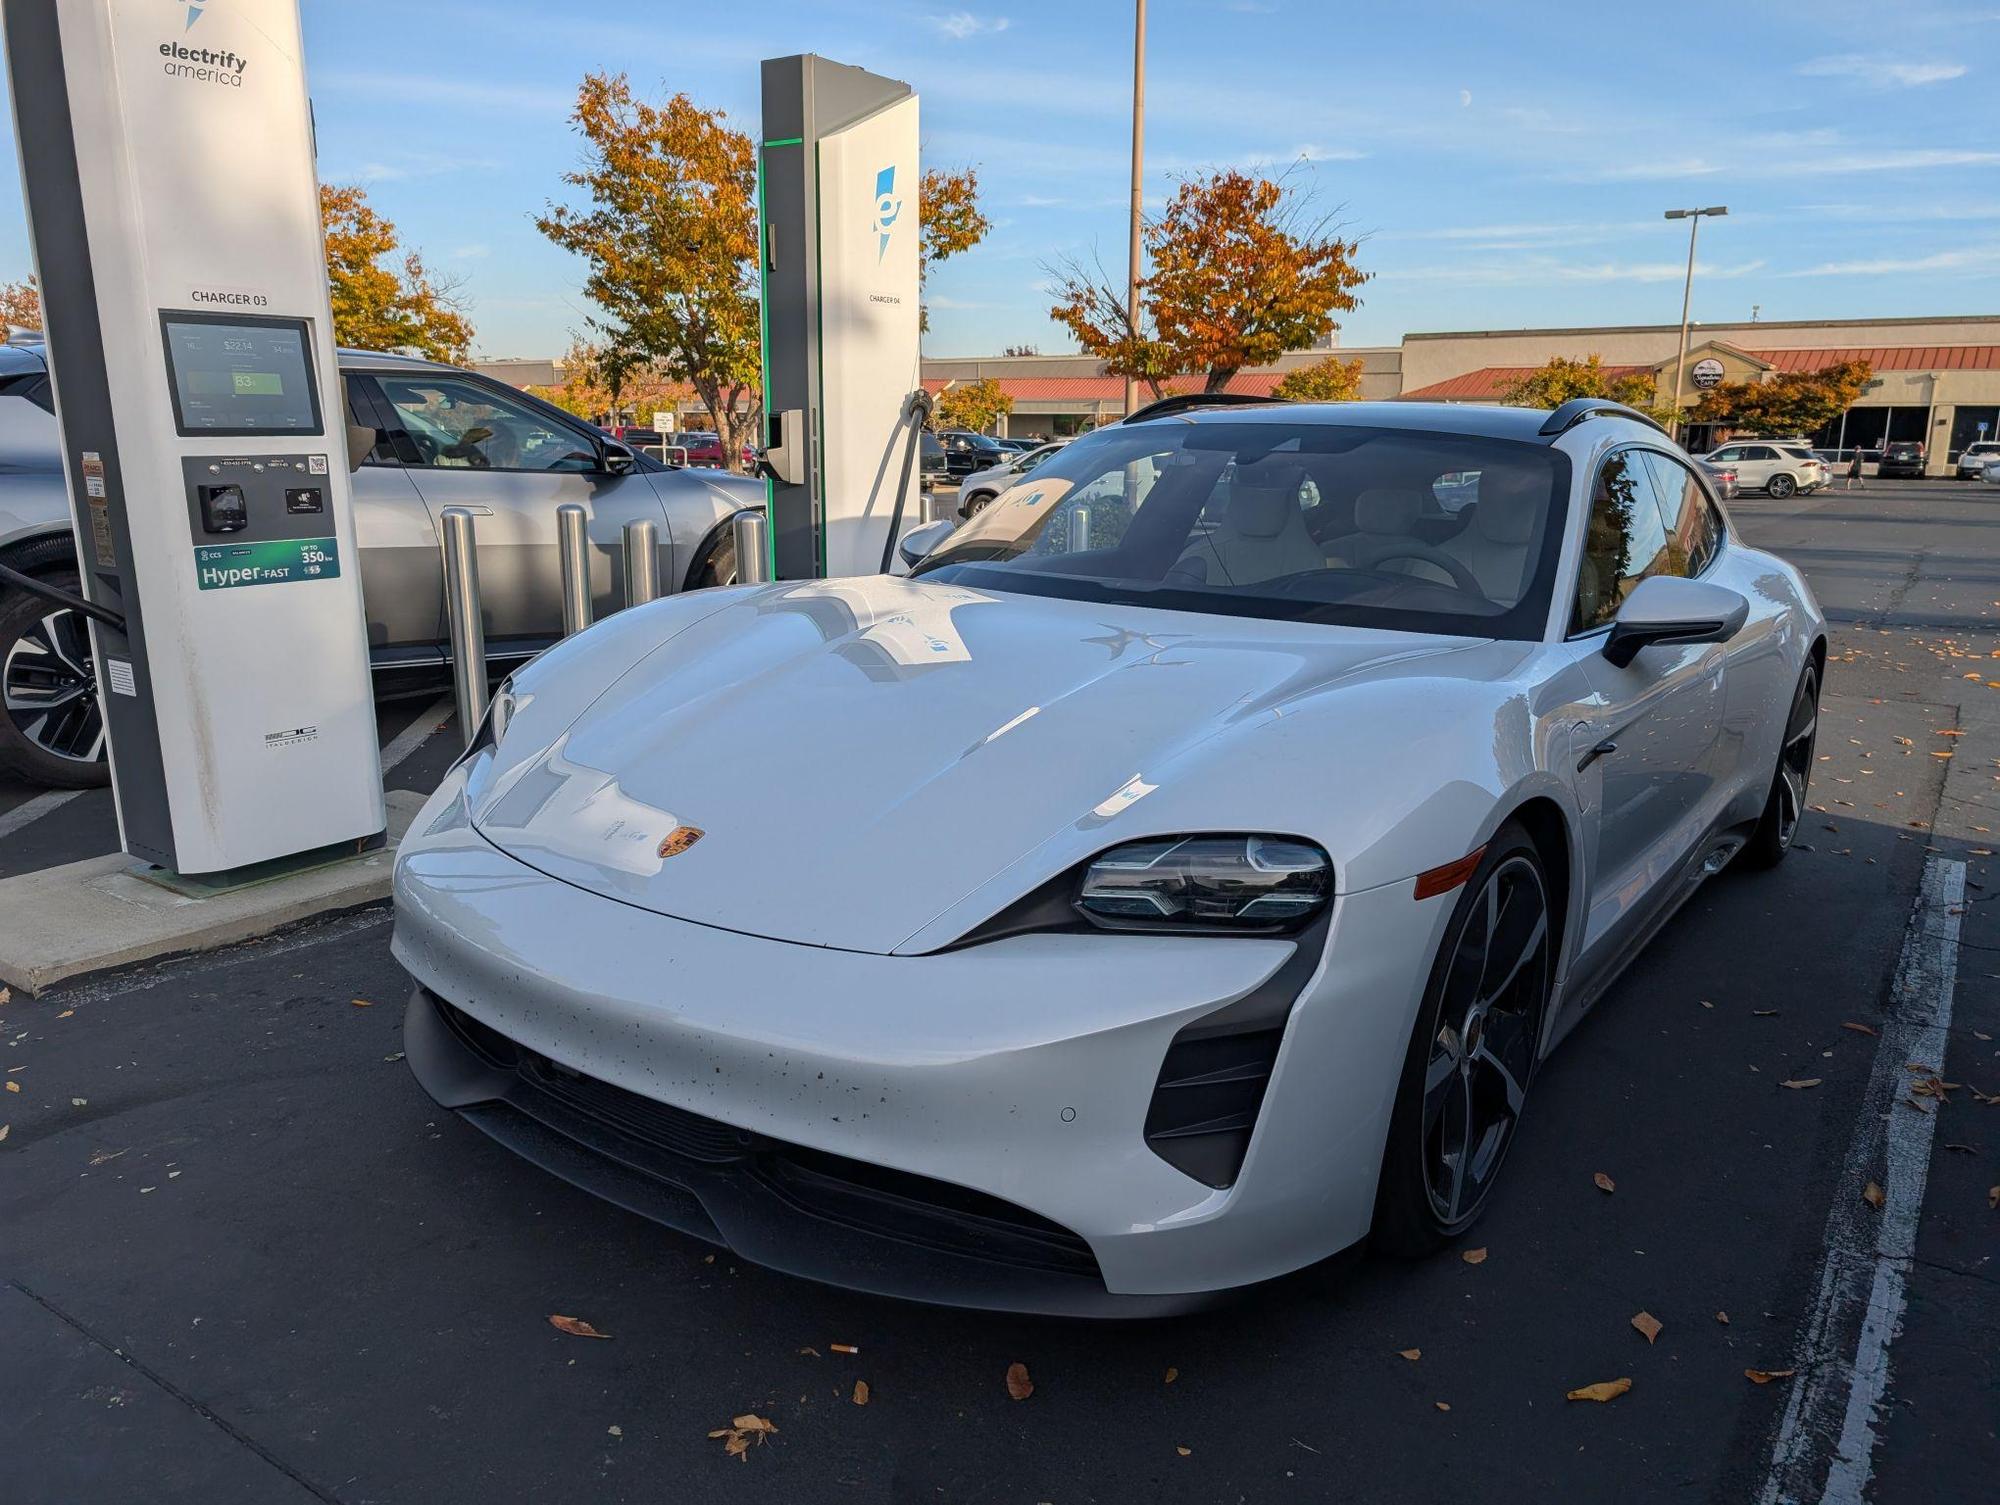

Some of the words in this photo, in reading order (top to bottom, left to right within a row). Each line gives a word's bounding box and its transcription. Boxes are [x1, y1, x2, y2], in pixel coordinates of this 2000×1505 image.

[160, 42, 247, 73] electrify
[164, 62, 242, 87] america
[191, 291, 251, 305] CHARGER
[253, 295, 268, 306] 03
[869, 294, 893, 304] CHARGER
[302, 551, 324, 563] 350
